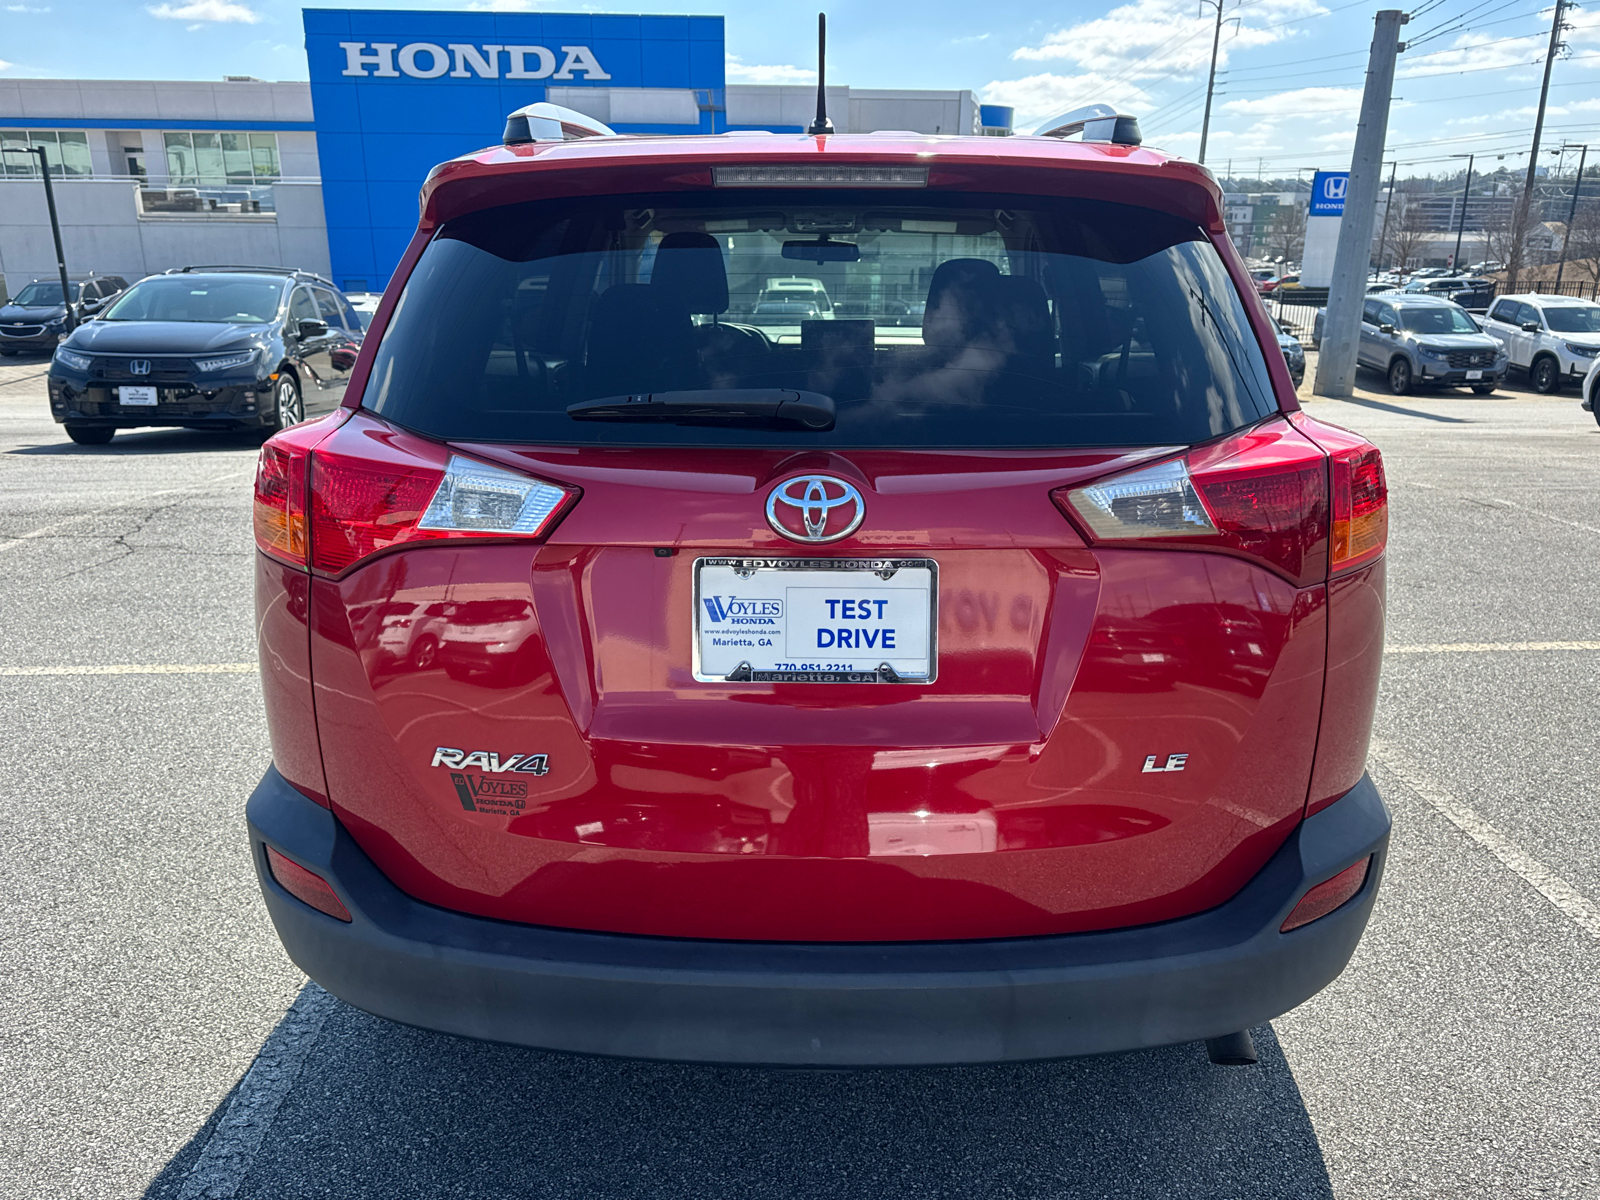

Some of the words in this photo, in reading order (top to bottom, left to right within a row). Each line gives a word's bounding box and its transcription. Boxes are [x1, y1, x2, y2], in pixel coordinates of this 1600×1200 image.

[339, 41, 612, 80] HONDA
[713, 595, 780, 621] VOYLES
[825, 599, 888, 620] TEST
[704, 628, 782, 636] www.edvoyleshonda.com
[817, 628, 896, 649] DRIVE
[712, 638, 755, 647] Marietta,
[758, 638, 773, 646] GA
[755, 672, 841, 682] Marietta,
[847, 672, 875, 682] GA
[431, 747, 550, 777] RAV4
[1141, 753, 1189, 773] LE
[454, 777, 465, 786] ED
[466, 774, 526, 797] VOYLES
[475, 798, 515, 808] HONDA
[479, 807, 509, 816] Marietta,
